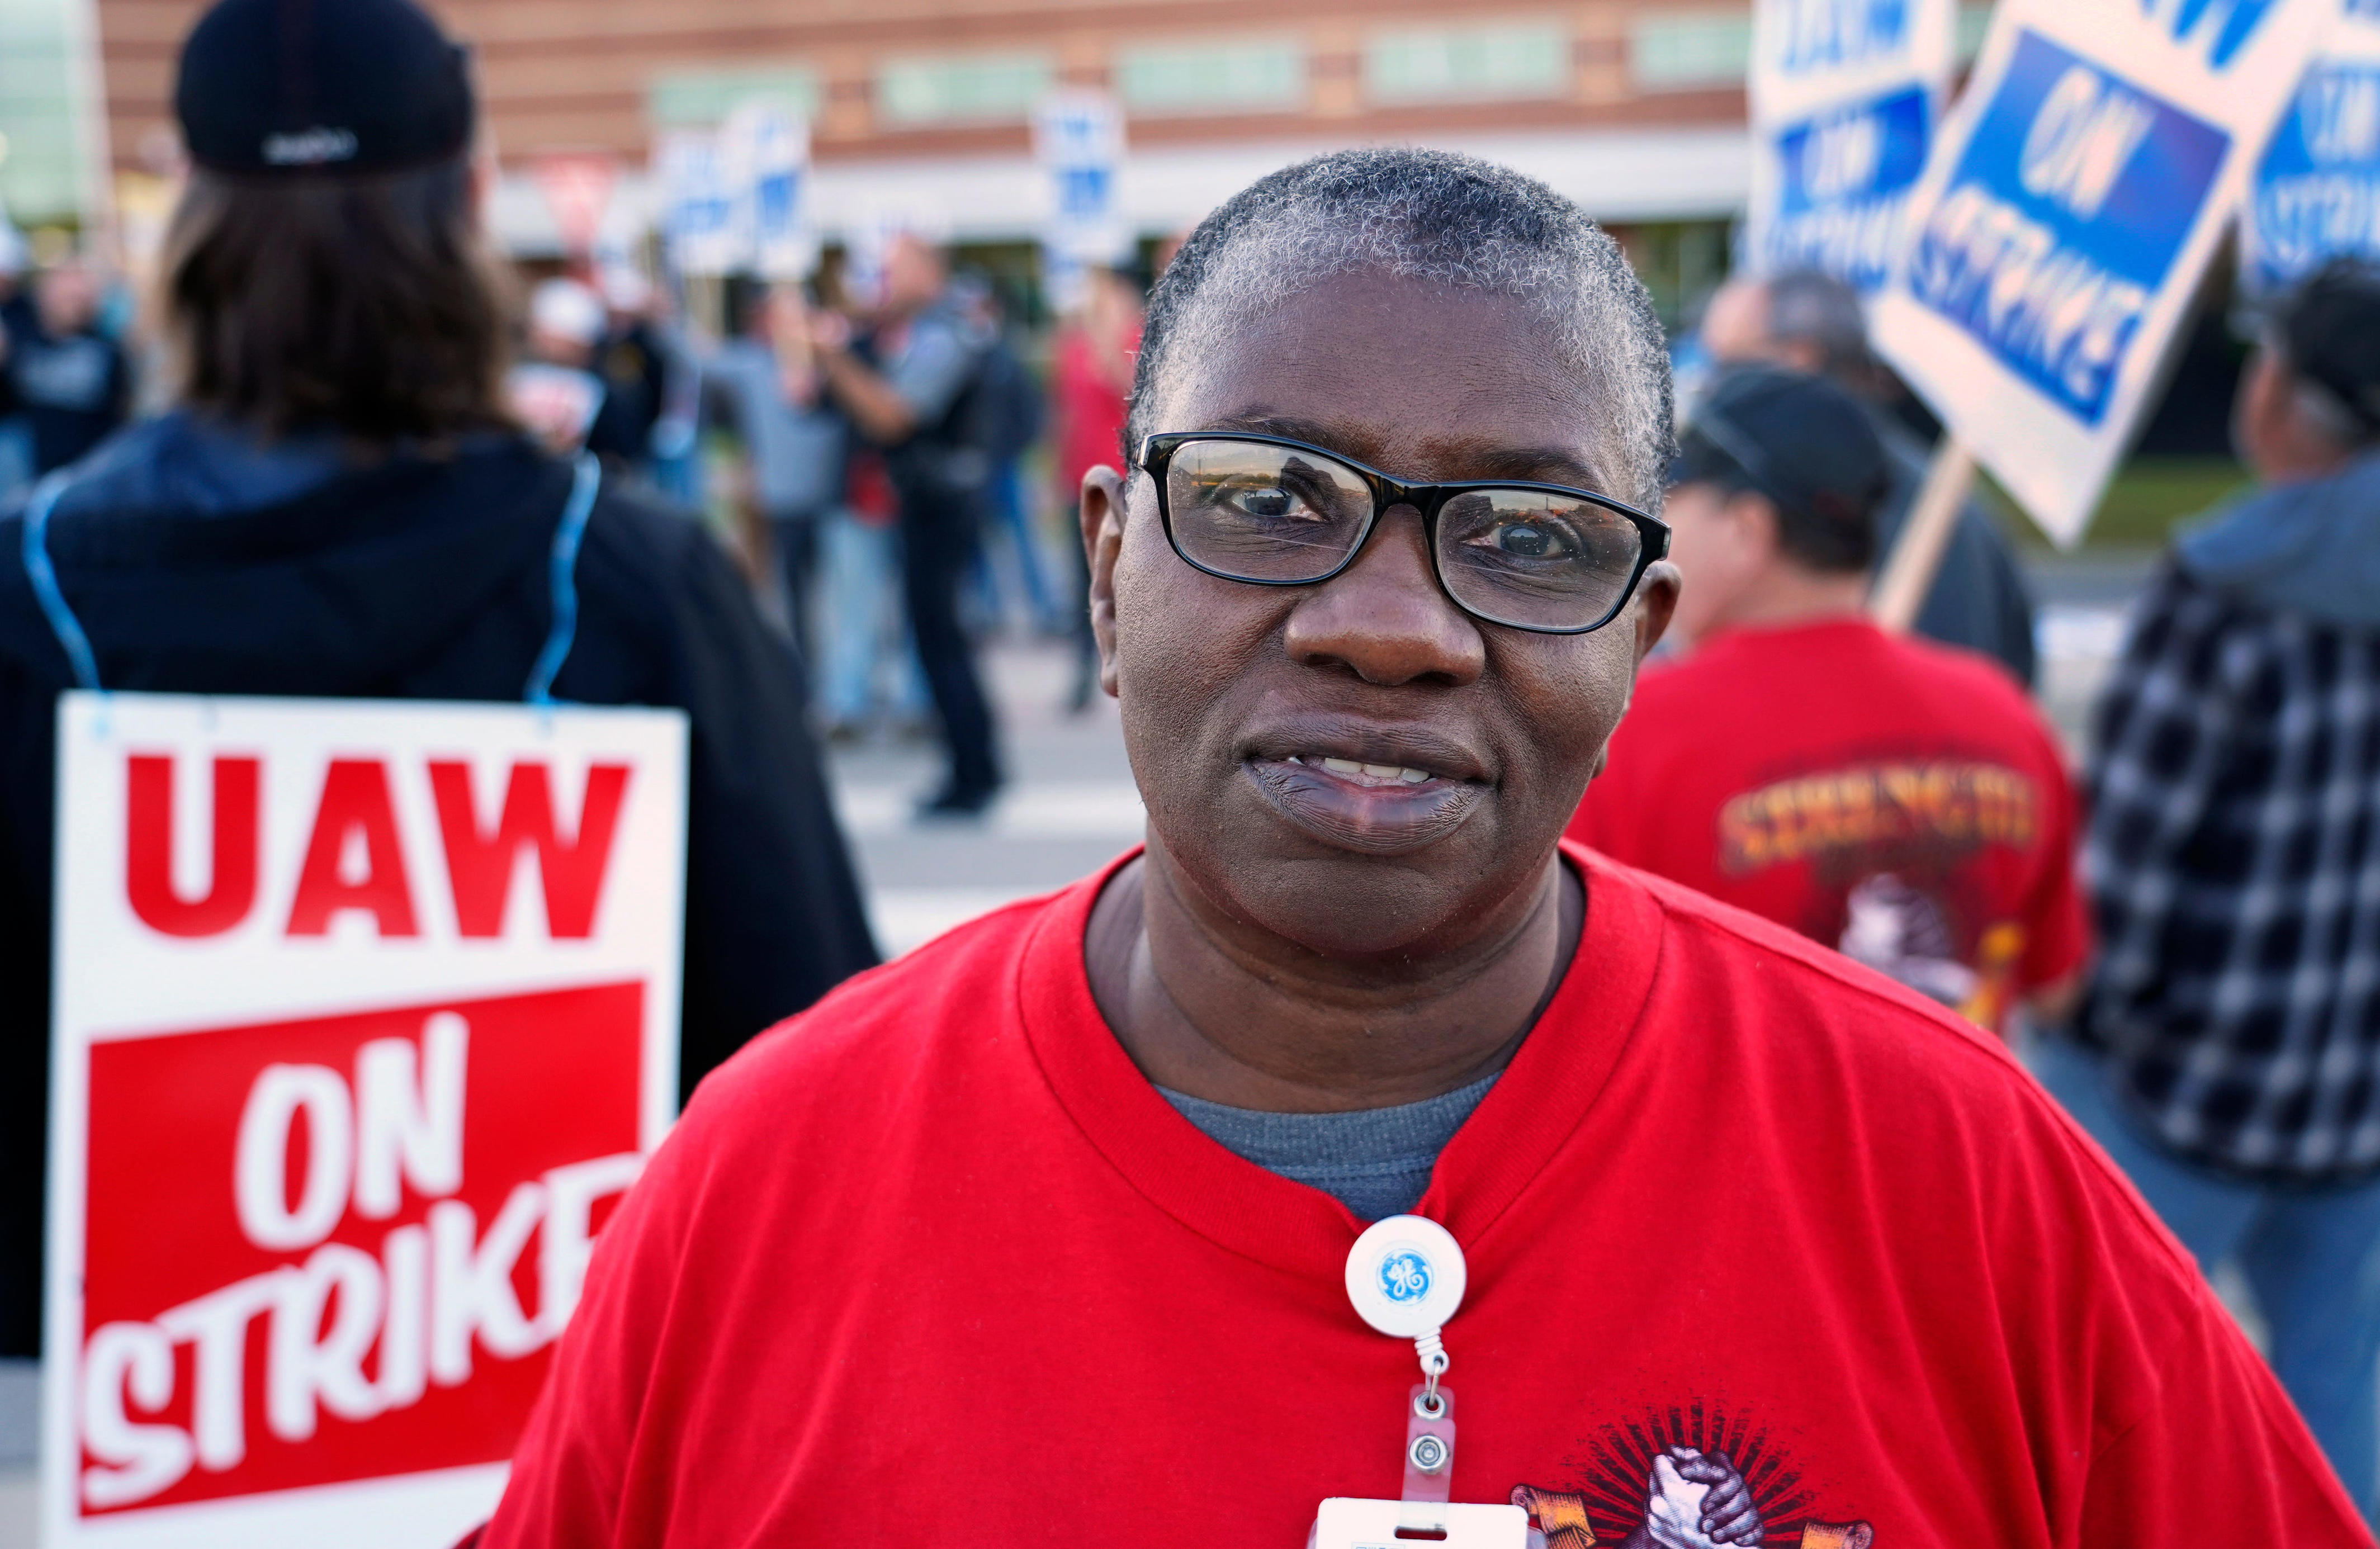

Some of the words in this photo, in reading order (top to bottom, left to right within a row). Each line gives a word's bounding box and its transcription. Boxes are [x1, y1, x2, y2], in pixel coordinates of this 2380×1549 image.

[2020, 63, 2157, 218] ON
[1912, 184, 2150, 400] STRIKE
[126, 754, 633, 940] UAW
[1717, 762, 2035, 877] STRENGTH
[234, 1013, 469, 1251] ON
[82, 1152, 643, 1508] STRIKE
